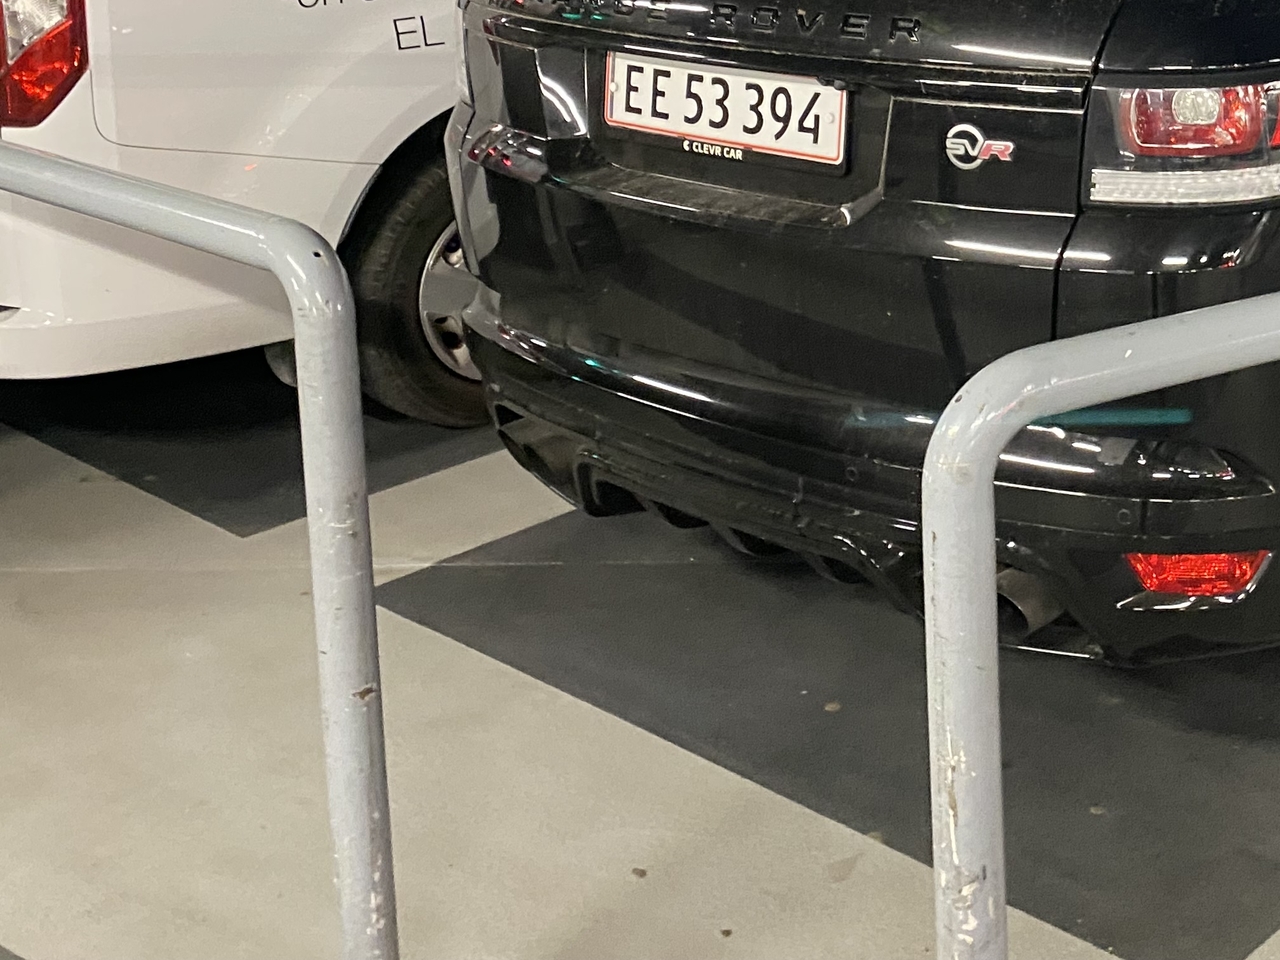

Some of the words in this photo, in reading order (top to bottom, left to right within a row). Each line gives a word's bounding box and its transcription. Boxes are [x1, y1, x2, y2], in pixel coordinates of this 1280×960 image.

[393, 15, 445, 50] EL
[708, 1, 922, 43] ROVER
[624, 64, 671, 120] EE
[683, 73, 730, 129] 53
[742, 82, 822, 145] 394
[692, 141, 722, 157] CLEVR
[723, 146, 743, 160] CAR
[945, 123, 1014, 170] SVR
